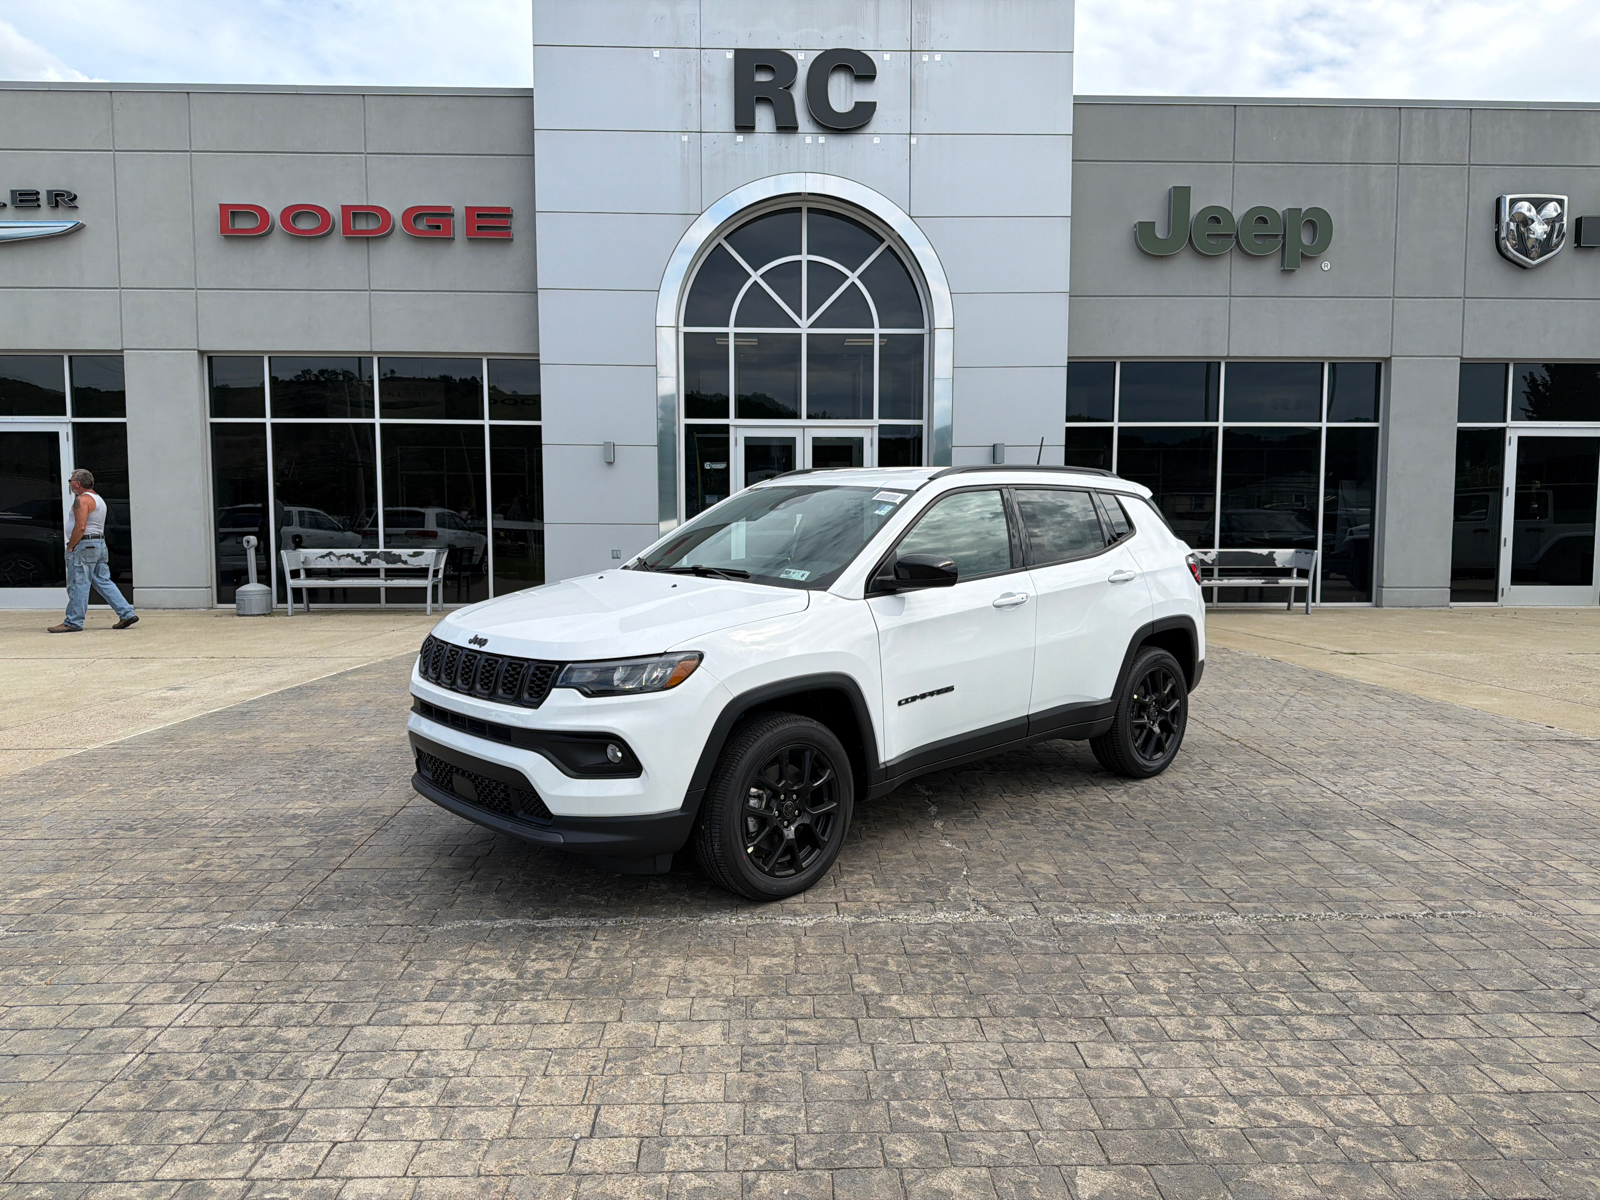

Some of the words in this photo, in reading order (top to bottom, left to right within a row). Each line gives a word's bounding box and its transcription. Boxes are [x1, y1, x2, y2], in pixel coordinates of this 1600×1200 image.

[733, 48, 878, 131] RC
[0, 188, 79, 208] ER
[218, 203, 513, 241] DODGE
[1134, 186, 1333, 271] Jeep
[468, 634, 489, 649] Jeep
[897, 685, 955, 707] COMPASS
